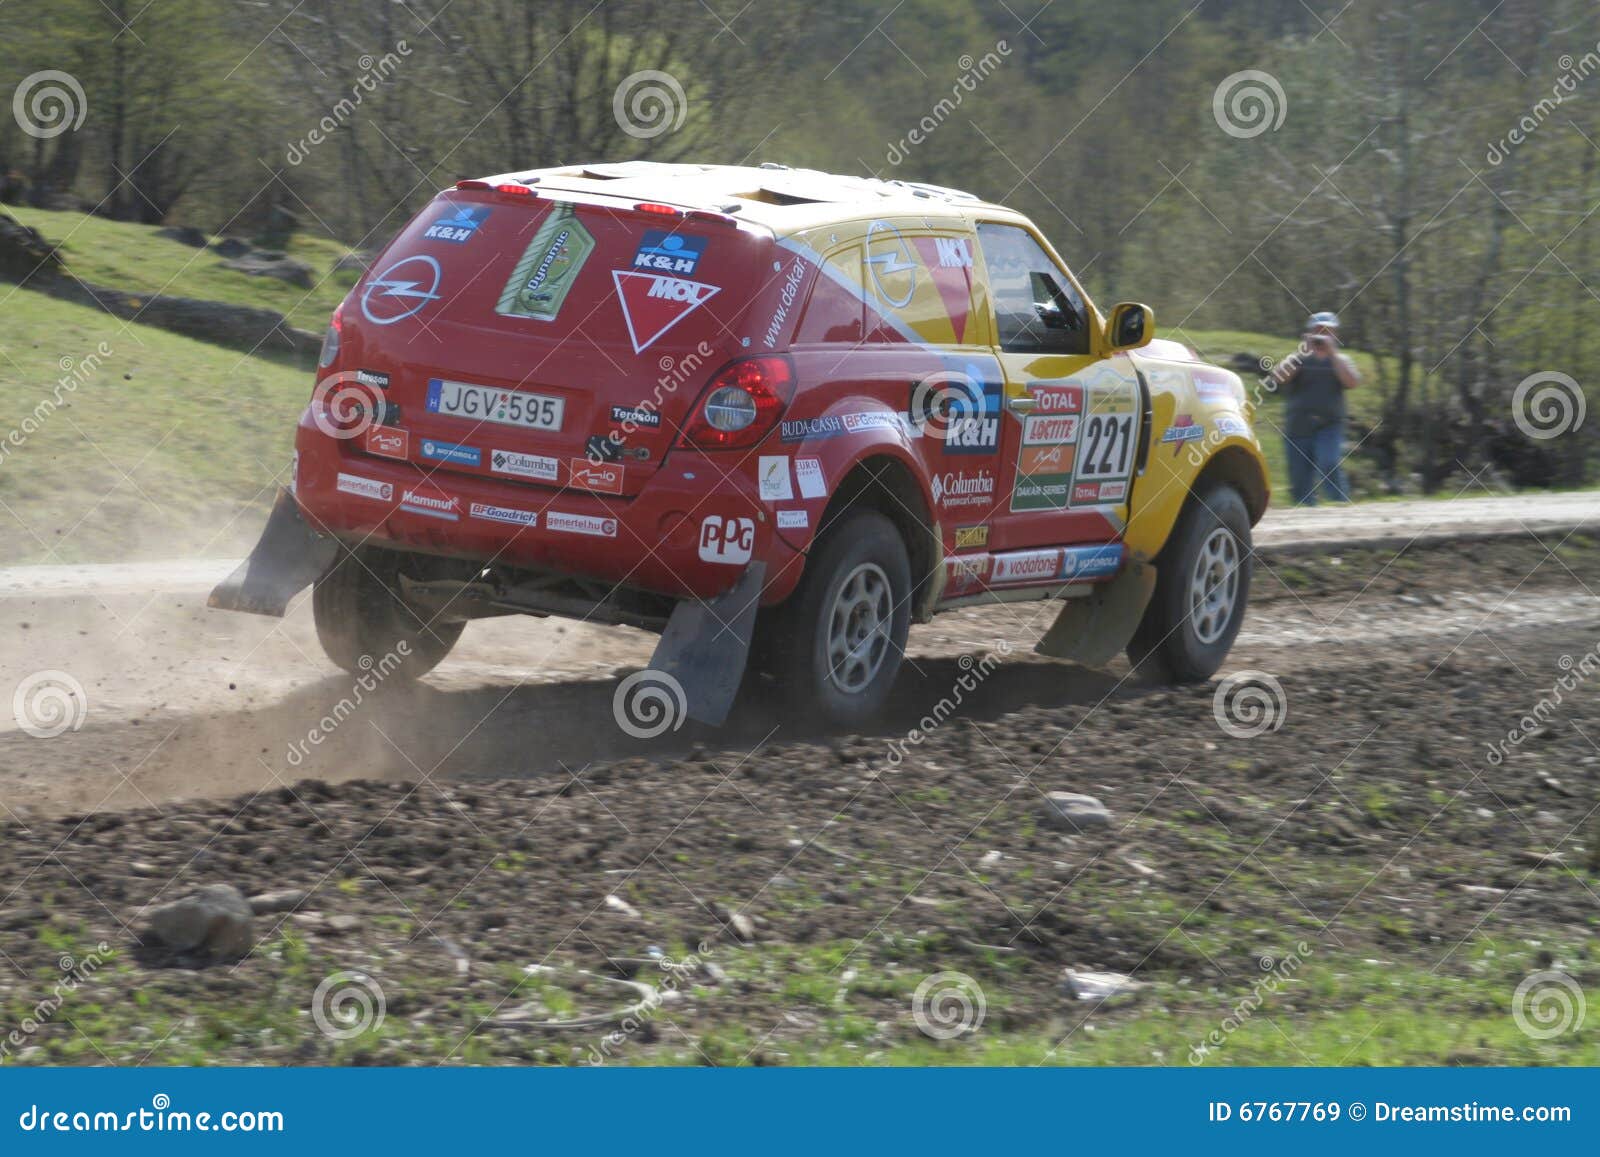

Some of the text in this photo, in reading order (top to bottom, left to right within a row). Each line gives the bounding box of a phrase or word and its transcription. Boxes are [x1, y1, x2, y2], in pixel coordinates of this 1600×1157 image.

[424, 225, 472, 241] K&H
[527, 230, 570, 290] Dynamic
[635, 253, 695, 273] K&H
[647, 278, 701, 304] MOL
[1033, 389, 1077, 409] TOTAL
[782, 417, 841, 437] BUDA-CASH
[945, 417, 998, 447] K&H
[1029, 420, 1075, 440] LOCTITE
[437, 448, 478, 460] MOTOROLA
[1082, 416, 1132, 475] 221
[507, 454, 556, 472] Columbia
[943, 470, 993, 495] Columbia
[403, 490, 454, 511] Mammut
[472, 505, 535, 523] BFGoodrich
[548, 517, 600, 531] genertel.hu
[1010, 556, 1057, 575] vodafone
